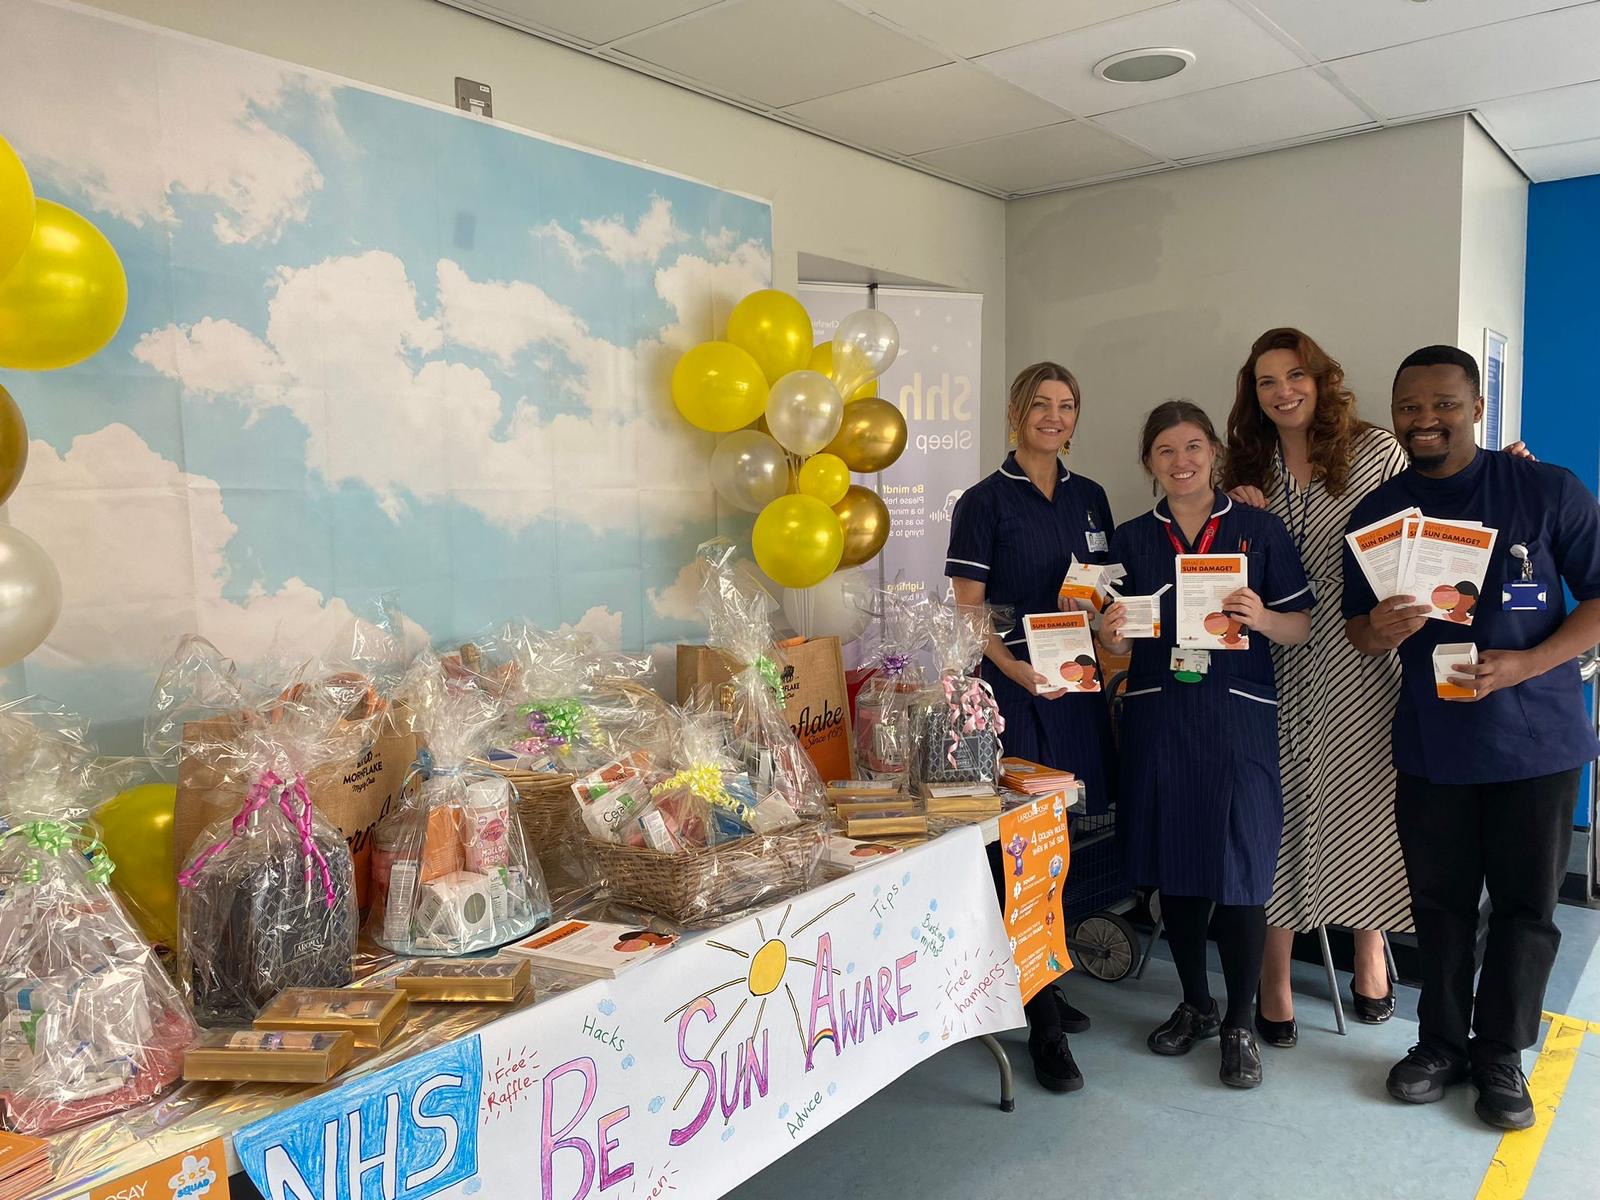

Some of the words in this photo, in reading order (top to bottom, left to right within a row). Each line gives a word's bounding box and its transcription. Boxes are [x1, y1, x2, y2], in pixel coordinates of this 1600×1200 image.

[1361, 539, 1378, 550] SUN
[1424, 530, 1441, 539] SUN
[1442, 533, 1481, 546] DAMAGE?
[1047, 621, 1078, 629] DAMAGE?
[343, 761, 383, 784] MORNFLAKE
[869, 883, 900, 921] Tips
[945, 969, 971, 1000] Free
[955, 963, 1005, 1014] hampers
[582, 1015, 625, 1052] Hacks
[668, 995, 770, 1147] SUN
[805, 932, 919, 1073] AWARE
[494, 1057, 527, 1084] Free
[487, 1075, 533, 1106] Raffle
[786, 1091, 824, 1139] Advice
[264, 1073, 463, 1200] NHS
[177, 1178, 211, 1198] SQUAD
